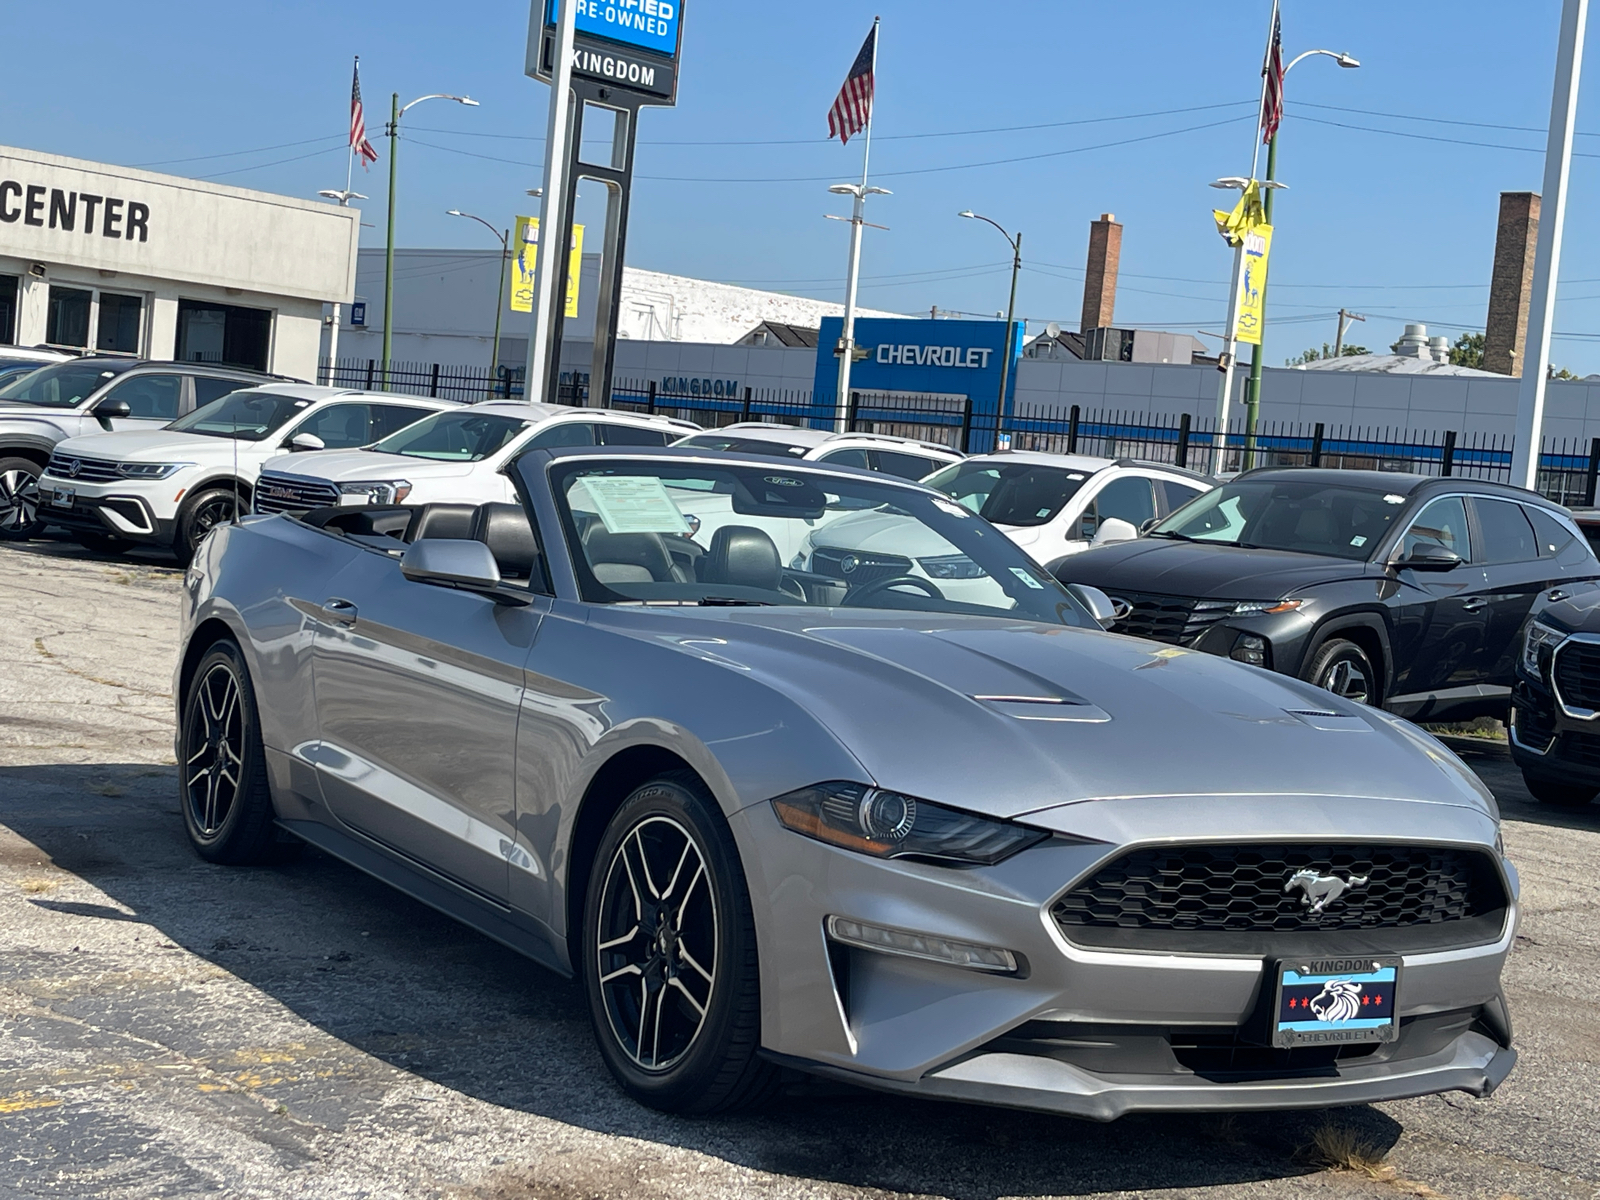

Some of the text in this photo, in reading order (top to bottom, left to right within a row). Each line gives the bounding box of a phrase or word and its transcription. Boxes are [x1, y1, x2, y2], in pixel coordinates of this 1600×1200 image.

[576, 0, 668, 37] RE-OWNED
[571, 49, 655, 86] KINGDOM
[0, 180, 151, 243] CENTER
[876, 344, 994, 369] CHEVROLET
[662, 376, 738, 397] KINGDOM
[269, 485, 302, 500] GMC
[1309, 959, 1374, 974] KINGDOM
[1302, 1030, 1369, 1044] CHEVROLET
